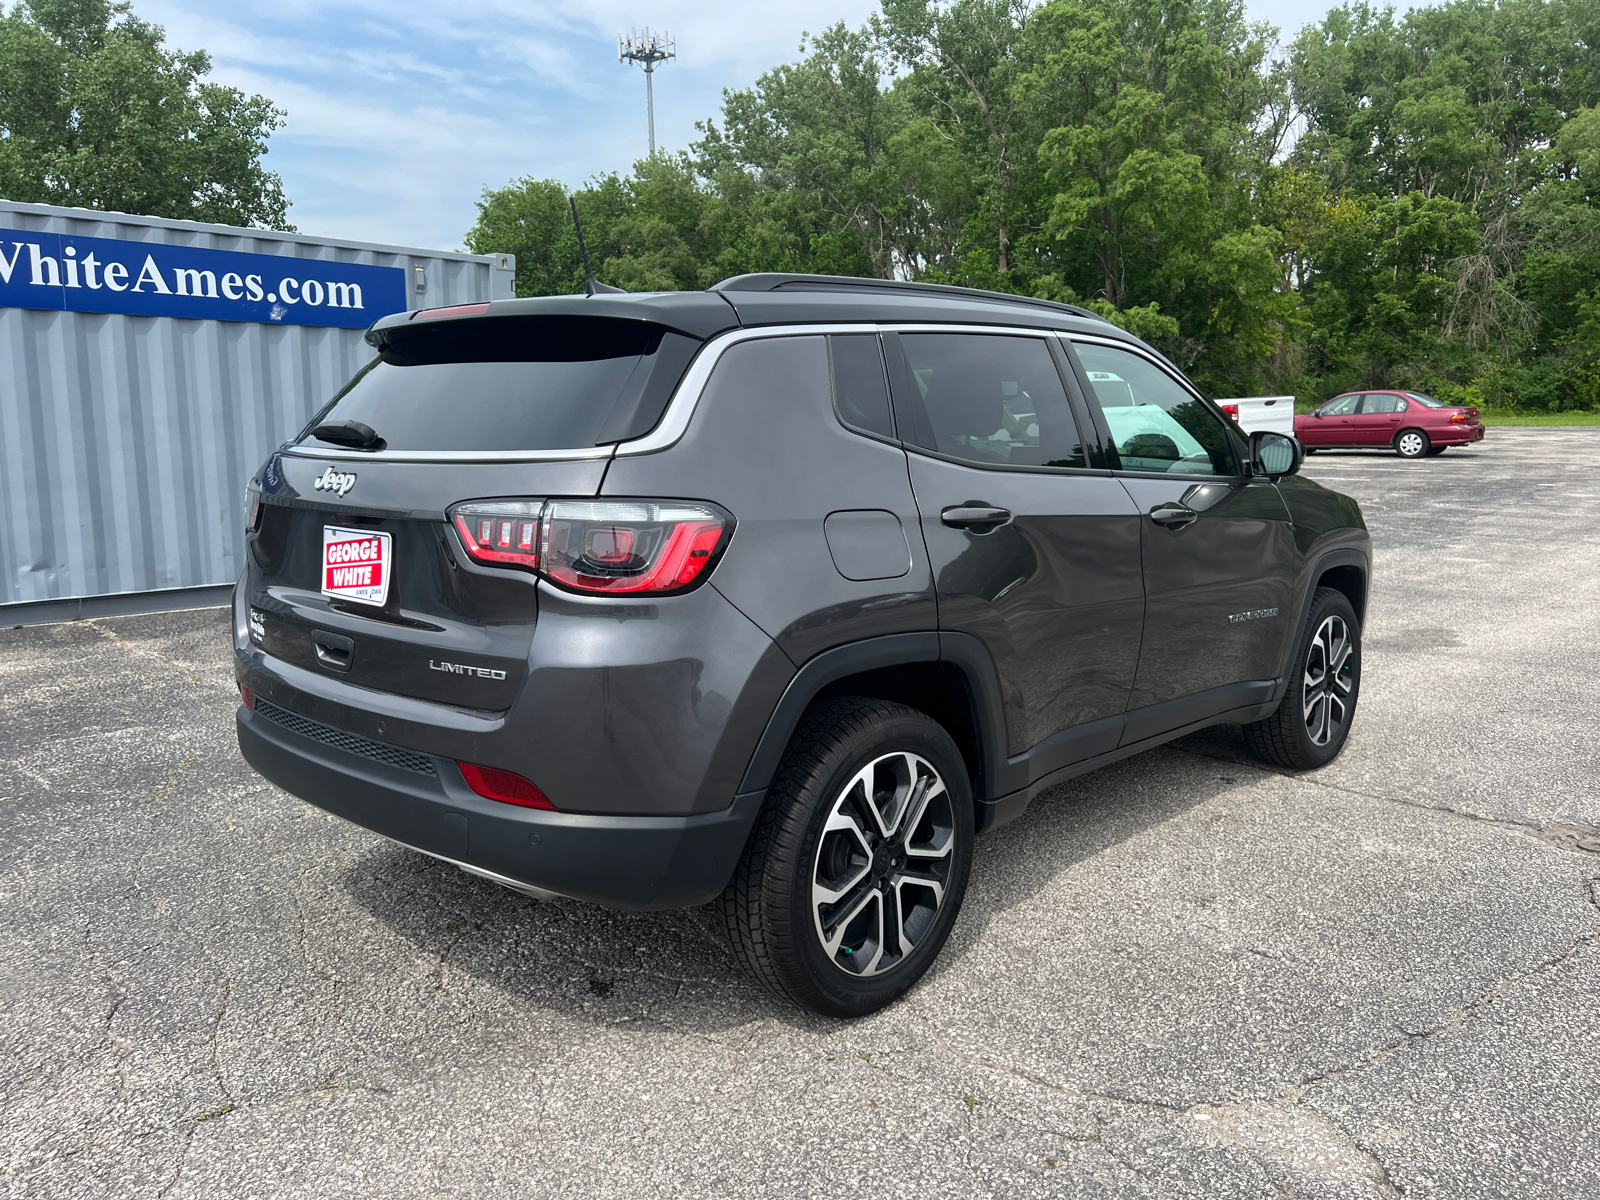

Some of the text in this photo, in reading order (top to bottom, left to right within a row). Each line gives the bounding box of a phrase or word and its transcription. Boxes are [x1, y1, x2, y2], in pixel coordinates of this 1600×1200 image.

[314, 466, 357, 498] Jeep
[328, 540, 379, 564] GEORGE
[333, 566, 373, 587] WHITE
[429, 659, 508, 681] LIMITED
